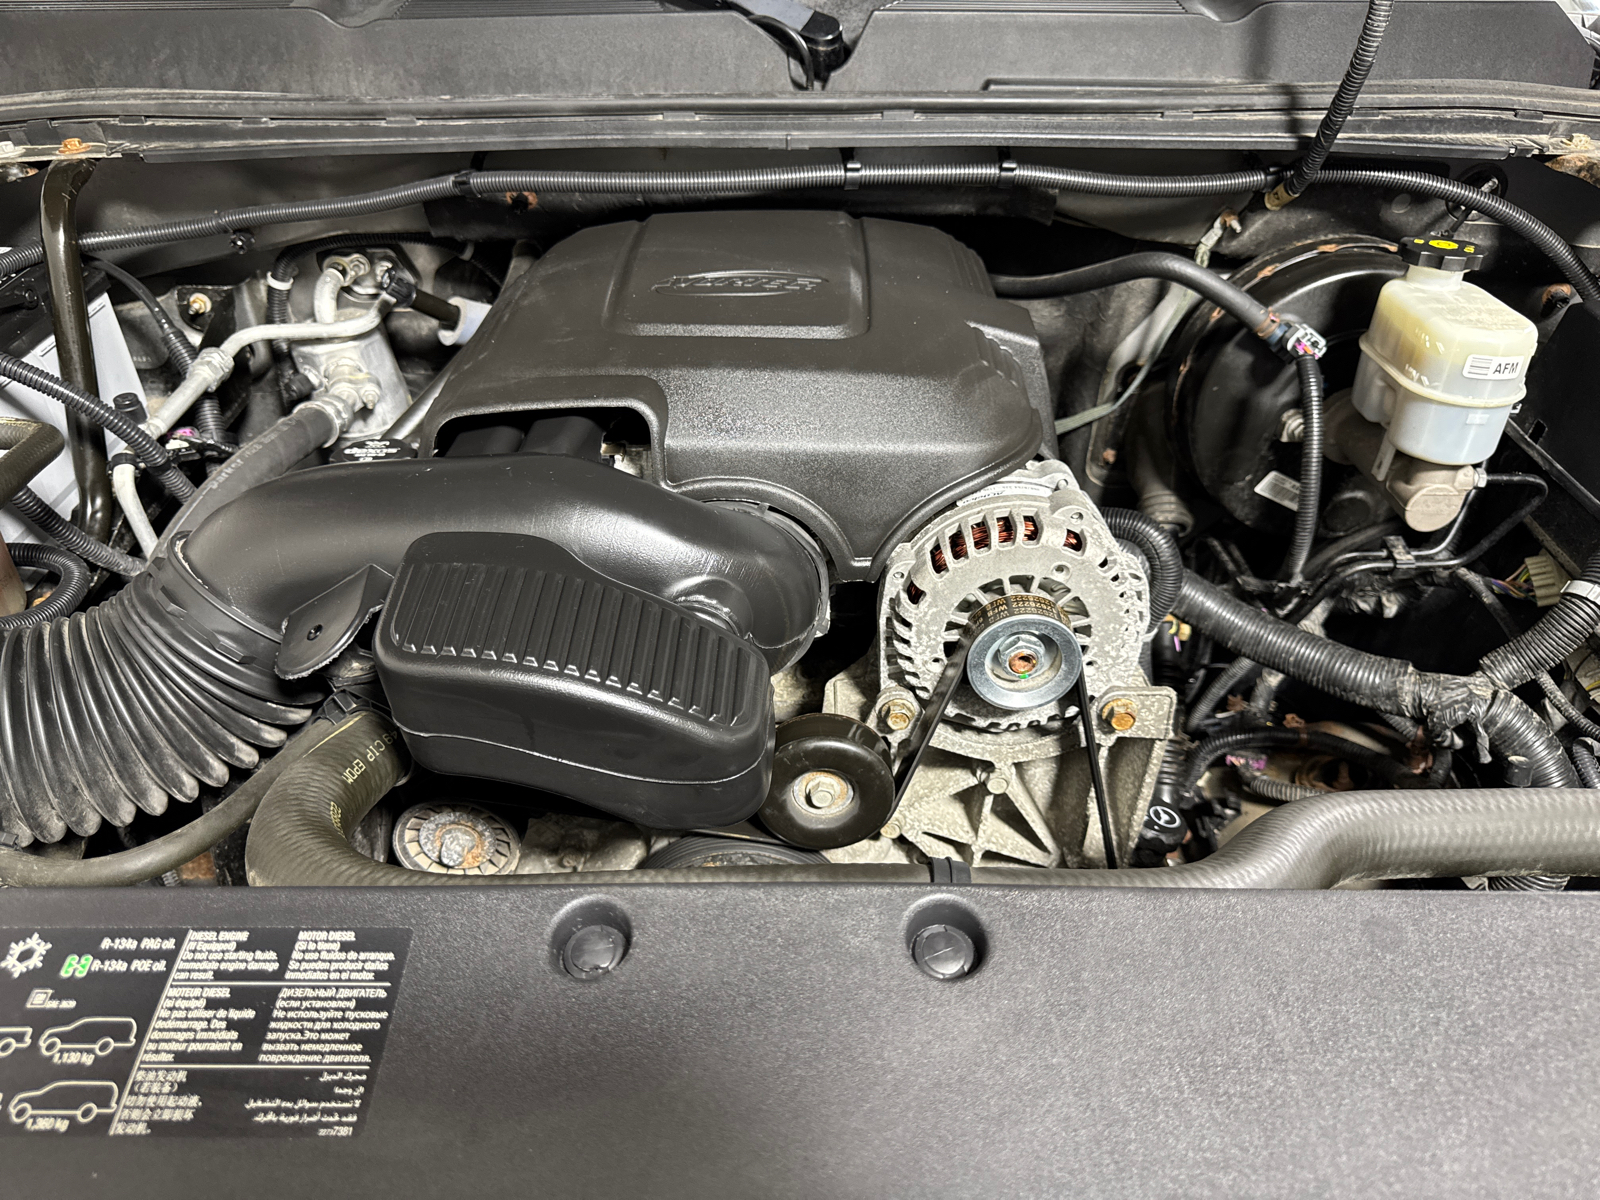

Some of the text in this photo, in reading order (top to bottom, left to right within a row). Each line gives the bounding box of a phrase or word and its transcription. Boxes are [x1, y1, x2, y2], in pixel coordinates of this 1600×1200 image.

[1492, 362, 1520, 375] AFM
[366, 740, 386, 762] CIP
[341, 758, 367, 785] EPDM
[190, 931, 250, 942] DIESEL ENGINE
[298, 931, 356, 941] MOTOR DIESEL
[100, 937, 176, 951] R-134a PAG oil.
[196, 941, 237, 952] Equipped)
[295, 941, 307, 952] (Si
[317, 941, 340, 951] tiene)
[182, 950, 278, 961] Do not use starting fluids.
[291, 950, 395, 962] No use fluidos de arranque.
[91, 959, 167, 972] R-134a POE oil.
[177, 960, 279, 972] Immediate engine damage
[288, 960, 389, 971] Se pueden producir daños
[174, 971, 214, 980] can result.
[284, 970, 375, 980] inmediatos en el motor.
[166, 987, 231, 998] MOTEUR DIESEL
[278, 987, 388, 998] ДИЗЕЛЬНЫЙ ДВИГАТЕЛЬ
[275, 999, 356, 1009] (если установлен)
[159, 1009, 171, 1018] Ne
[171, 1010, 187, 1020] pas
[187, 1009, 216, 1018] utiliser
[216, 1009, 228, 1018] de
[272, 1009, 389, 1020] Не используйте пусковые
[209, 1020, 227, 1029] Des
[268, 1020, 381, 1031] жидкости для холодного
[150, 1031, 196, 1042] dommages
[320, 1031, 350, 1041] может
[145, 1042, 243, 1053] au moteur pourraient en
[261, 1042, 364, 1053] вызвать немедленное
[80, 1051, 95, 1067] kg
[257, 1053, 372, 1064] повреждение двигателя.
